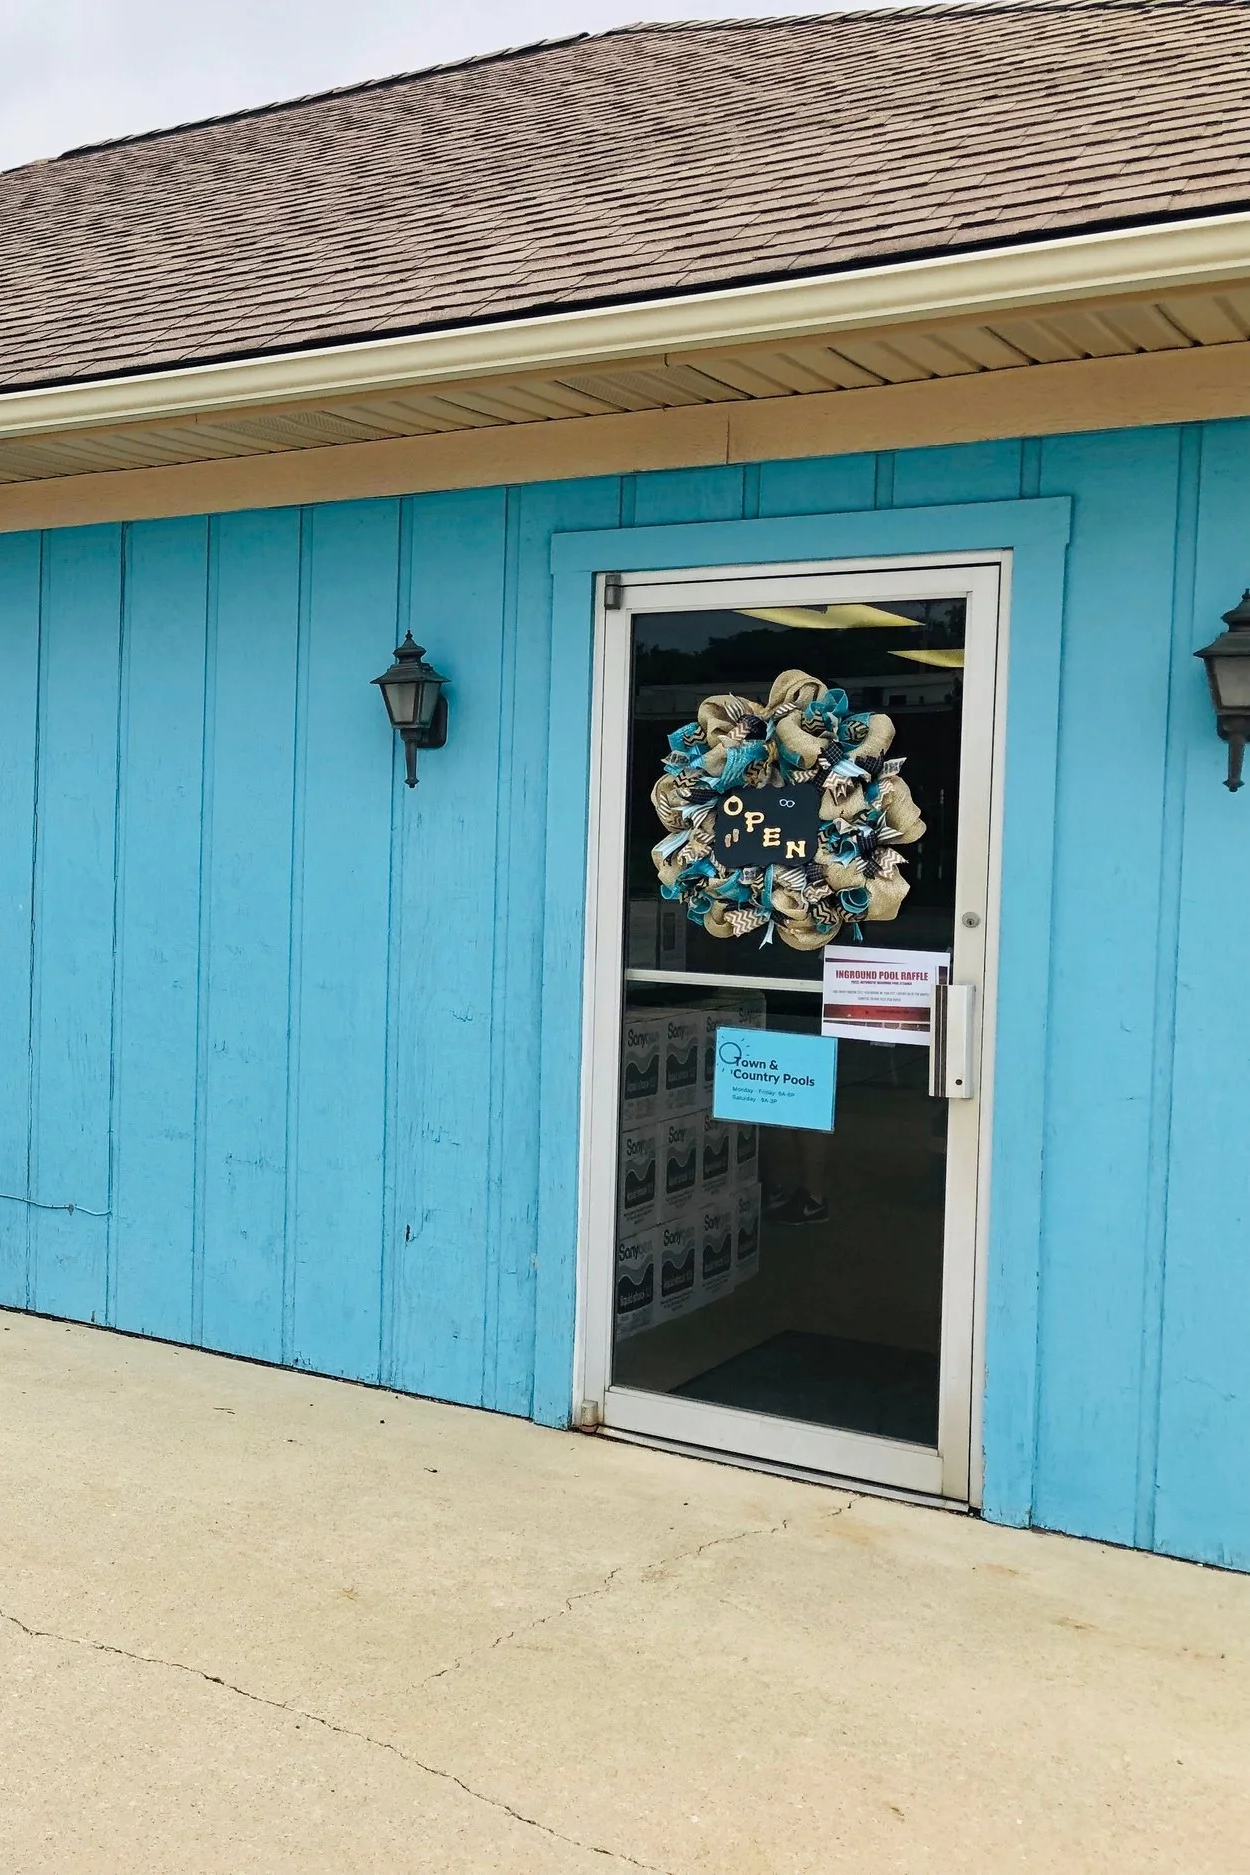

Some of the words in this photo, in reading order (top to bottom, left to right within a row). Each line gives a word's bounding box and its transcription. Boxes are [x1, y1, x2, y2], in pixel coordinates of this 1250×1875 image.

[723, 795, 806, 859] OPEN
[835, 970, 877, 980] INGROUND
[878, 971, 900, 981] POOL
[900, 971, 929, 981] RAFFLE
[733, 1056, 767, 1070] Town
[769, 1059, 779, 1071] &
[733, 1068, 781, 1085] Country
[783, 1073, 816, 1087] Pools
